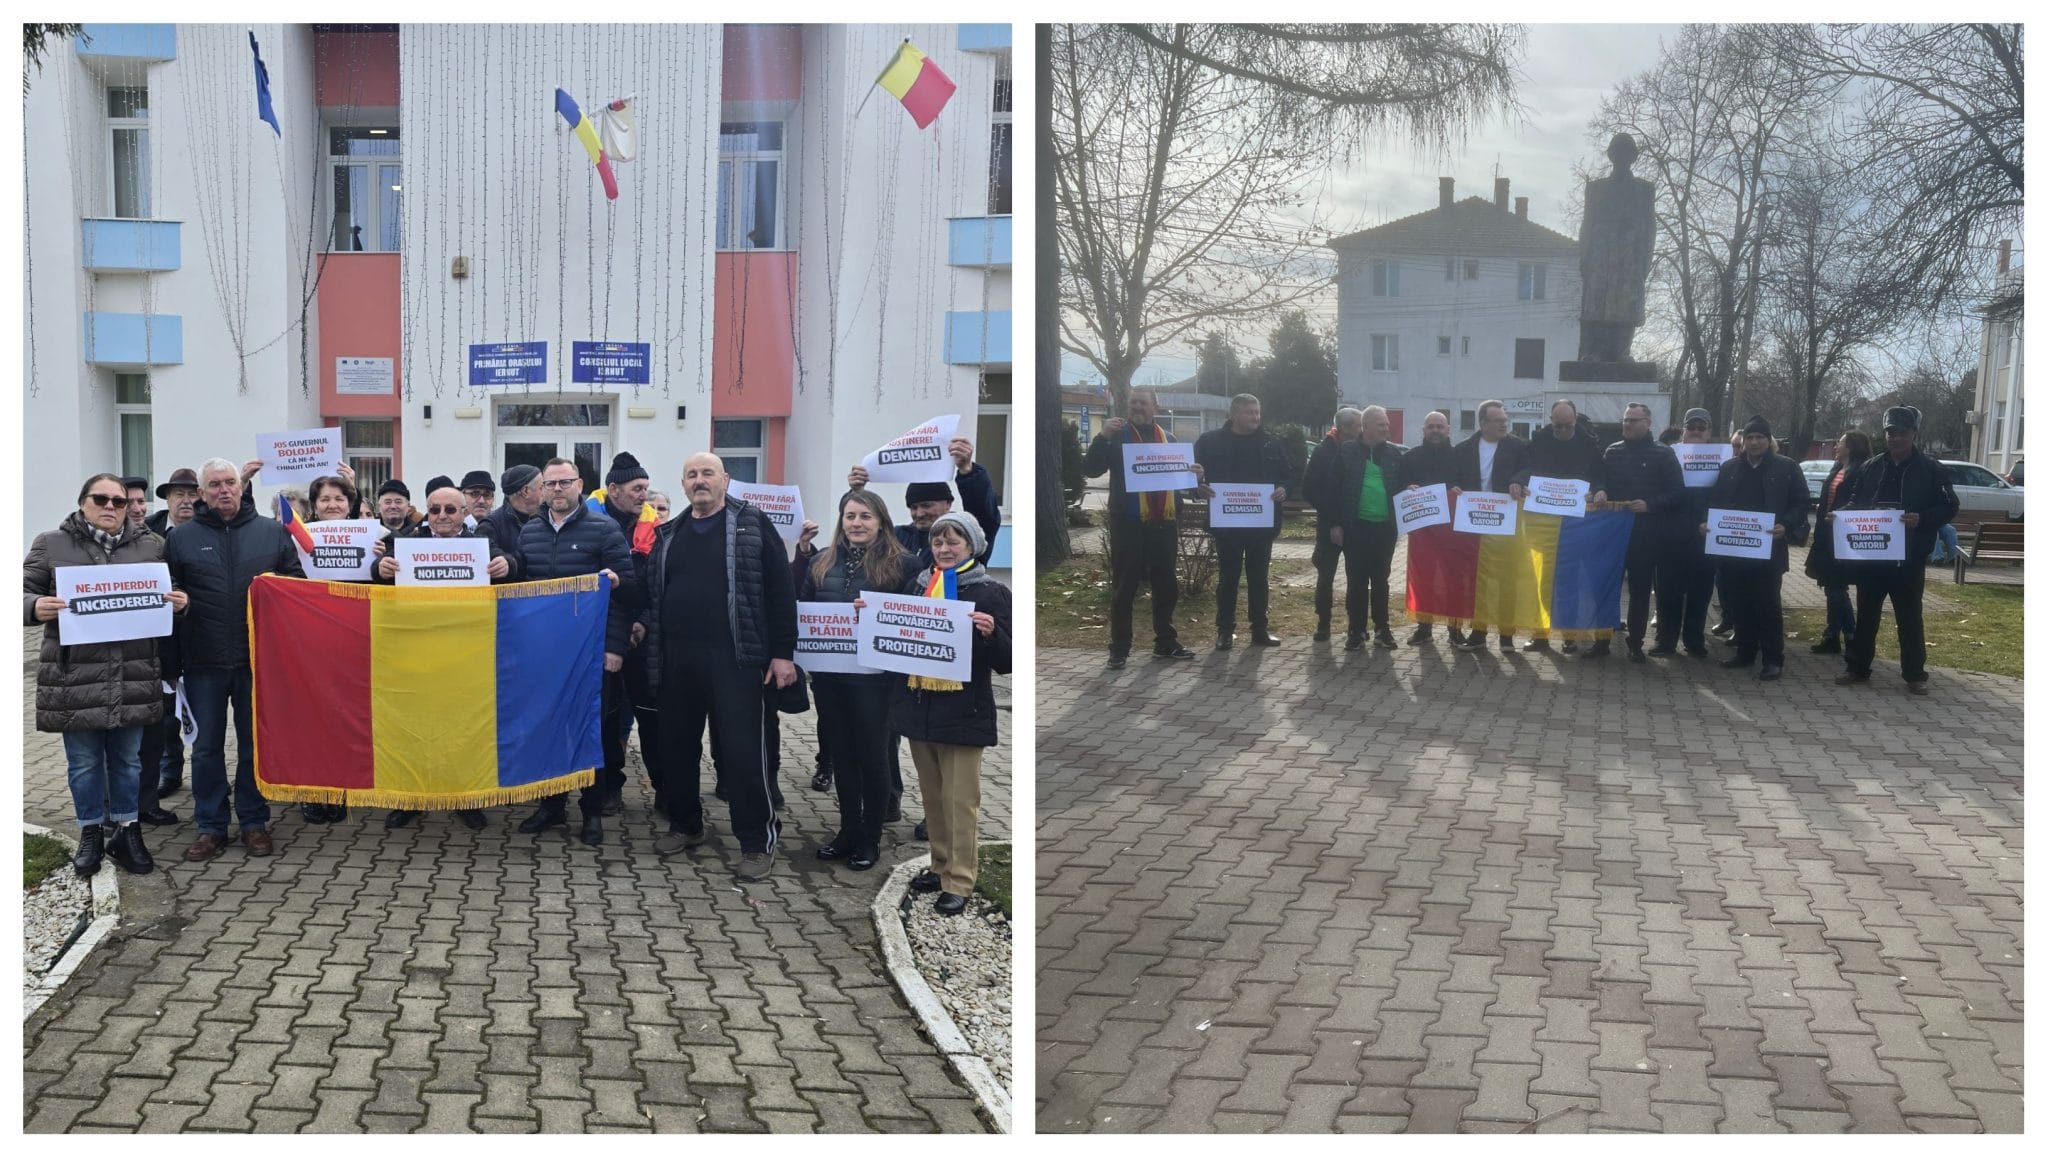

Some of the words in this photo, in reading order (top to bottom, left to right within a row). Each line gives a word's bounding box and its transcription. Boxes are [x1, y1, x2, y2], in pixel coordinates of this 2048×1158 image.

[580, 358, 619, 366] CONSILIUL
[620, 358, 643, 367] LOCAL
[1082, 406, 1087, 416] P
[273, 441, 287, 449] JOS
[288, 438, 328, 447] GUVERNUL
[278, 446, 325, 457] BOLOJAN
[881, 448, 940, 463] DEMISIA!
[1136, 463, 1189, 472] INCREDEREA!
[742, 492, 775, 501] GUVERN
[1224, 505, 1262, 513] DEMISIA!
[310, 525, 338, 534] UCRĂM
[340, 526, 368, 534] PENTRU
[1856, 524, 1880, 532] TAXE
[322, 534, 351, 544] TAXE
[1718, 536, 1761, 546] PROTEJEAZĂ!
[316, 548, 341, 557] TRĂIM
[342, 548, 357, 557] DIN
[412, 553, 429, 562] VOI
[432, 552, 475, 563] DECIDEȚI,
[317, 558, 358, 568] DATORII
[418, 568, 436, 578] NOI
[437, 566, 470, 578] PLĂTIM
[76, 582, 111, 594] NE-AȚI
[114, 580, 158, 591] PIERDUT
[76, 594, 163, 612] INCREDEREA!
[884, 601, 932, 616] GUVERNUL
[934, 607, 947, 617] NE
[800, 613, 849, 624] REFUZĂM
[853, 615, 859, 624] S
[878, 612, 954, 633] ÎMPOVĂREAZĂ,
[809, 625, 853, 637] PLĂTIM
[900, 629, 912, 638] NU
[914, 630, 926, 639] NE
[797, 641, 858, 652] INCOMPETEN
[878, 638, 953, 659] PROTEJEAZĂ!
